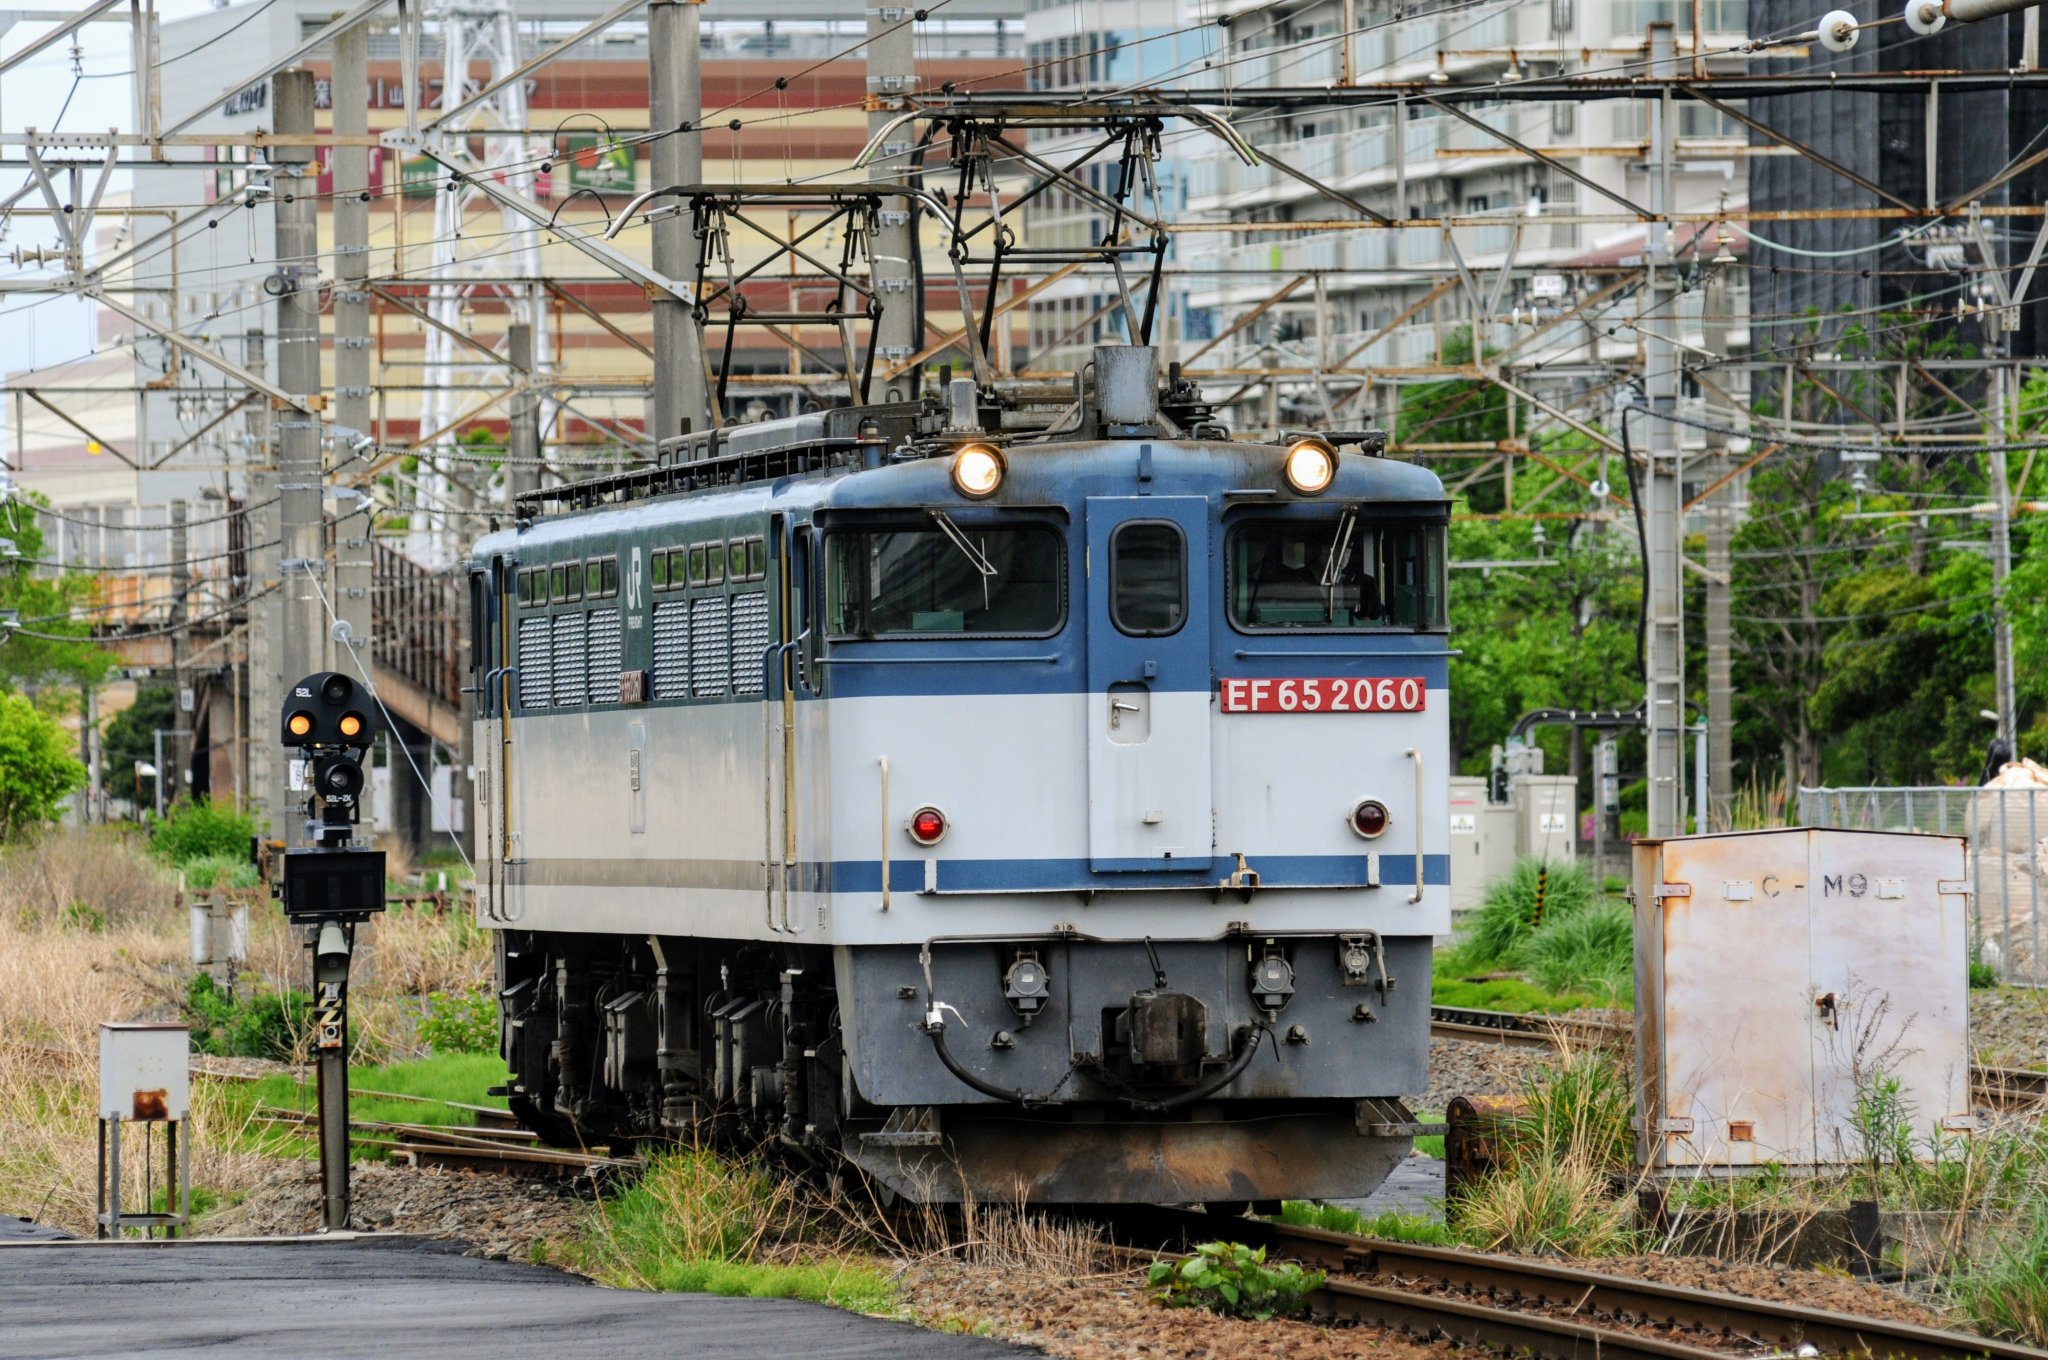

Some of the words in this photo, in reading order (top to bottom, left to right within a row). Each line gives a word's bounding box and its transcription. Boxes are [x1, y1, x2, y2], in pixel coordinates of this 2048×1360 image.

[627, 547, 642, 610] JR
[296, 687, 312, 698] 52L
[1228, 680, 1271, 711] EF
[1278, 680, 1321, 711] 65
[1331, 679, 1419, 711] 2060
